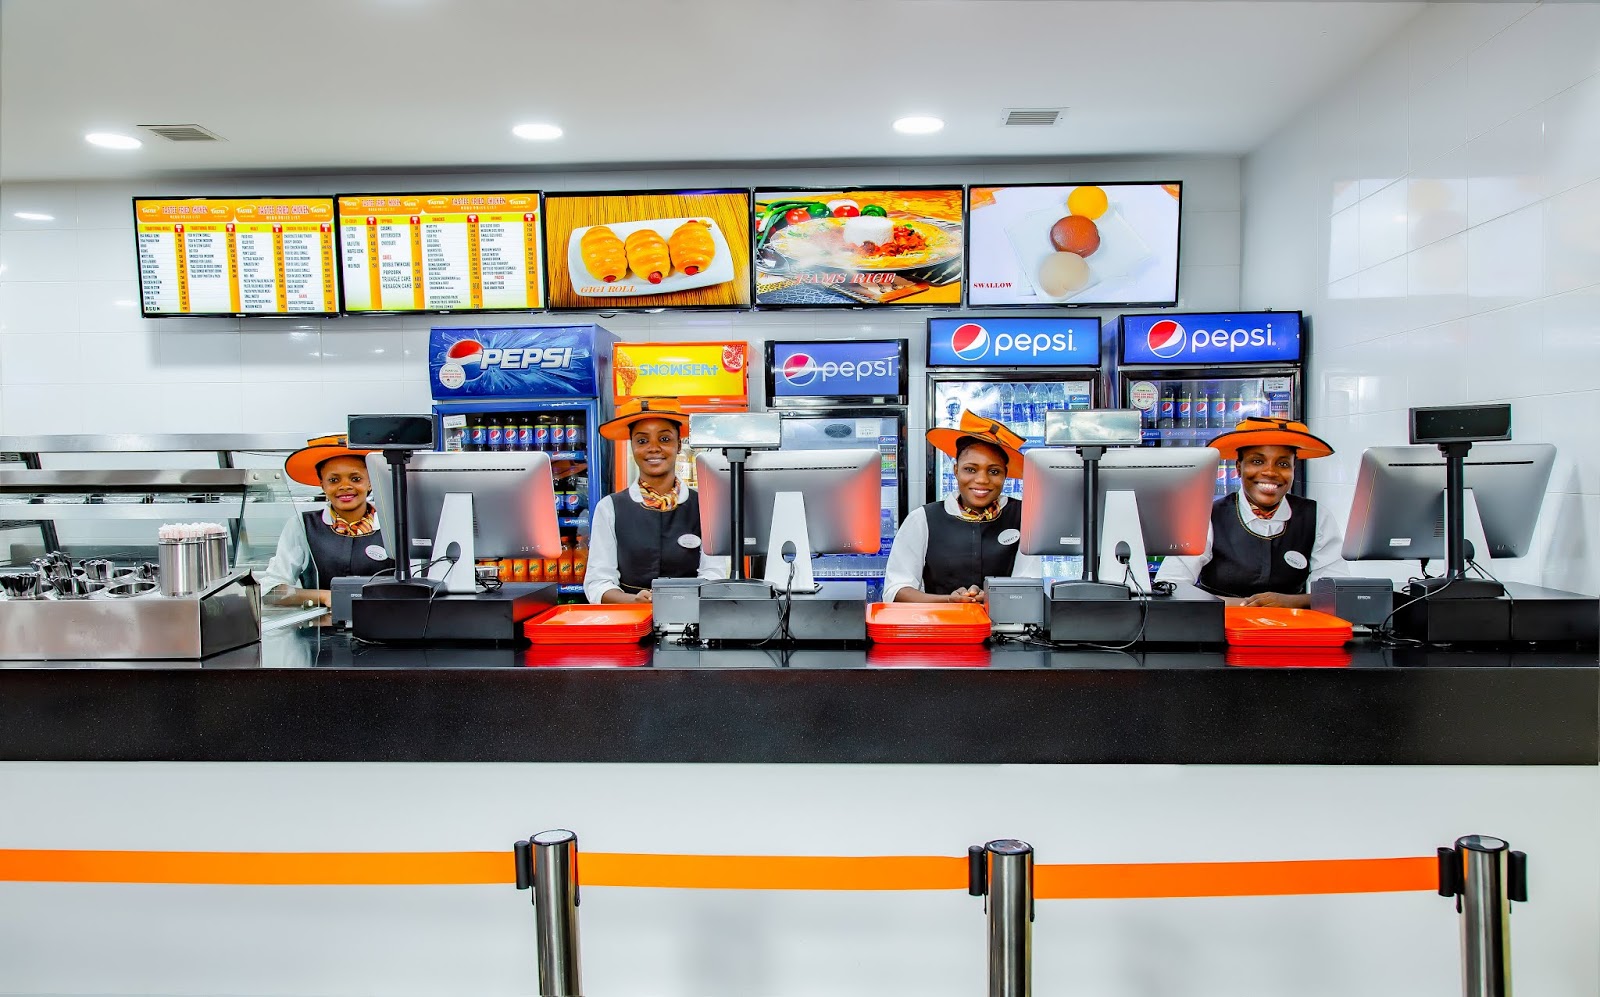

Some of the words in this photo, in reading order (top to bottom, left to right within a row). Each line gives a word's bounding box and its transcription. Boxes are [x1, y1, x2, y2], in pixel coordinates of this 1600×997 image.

[580, 285, 605, 293] GIGI
[608, 285, 638, 293] ROLL
[850, 272, 897, 284] RICE
[994, 328, 1073, 357] pepsi
[1191, 323, 1272, 353] pepsi
[480, 347, 573, 370] PEPSI
[822, 356, 892, 382] pepsi
